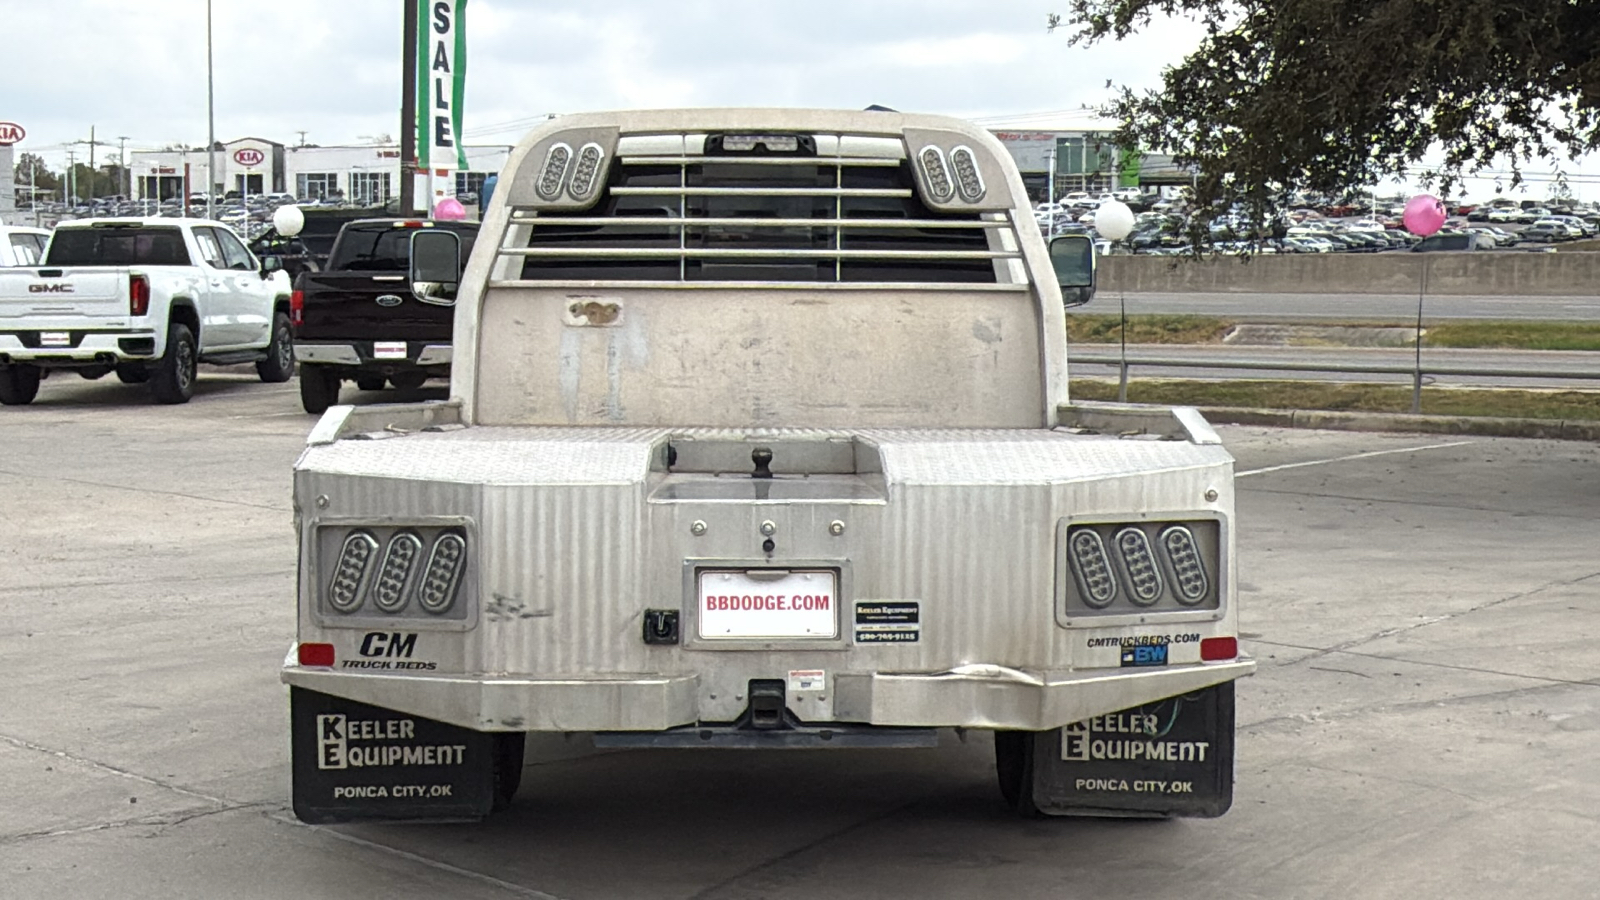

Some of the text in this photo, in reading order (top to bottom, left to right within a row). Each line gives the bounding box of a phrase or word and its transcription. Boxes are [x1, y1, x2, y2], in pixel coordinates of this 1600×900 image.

[433, 1, 453, 147] SALE
[0, 127, 19, 140] IA
[239, 151, 259, 162] KIA
[28, 284, 75, 293] GMC
[706, 594, 830, 611] BBDODGE.COM
[359, 631, 418, 658] CM
[1086, 633, 1201, 648] CMTRUCKBEDS.COM
[342, 660, 438, 671] TRUCK BEDS
[321, 716, 415, 740] KEELER
[322, 743, 467, 768] EQUIPMENT
[1066, 734, 1210, 762] EQUIPMENT
[334, 786, 388, 798] PONCA
[1075, 778, 1129, 791] PONCA
